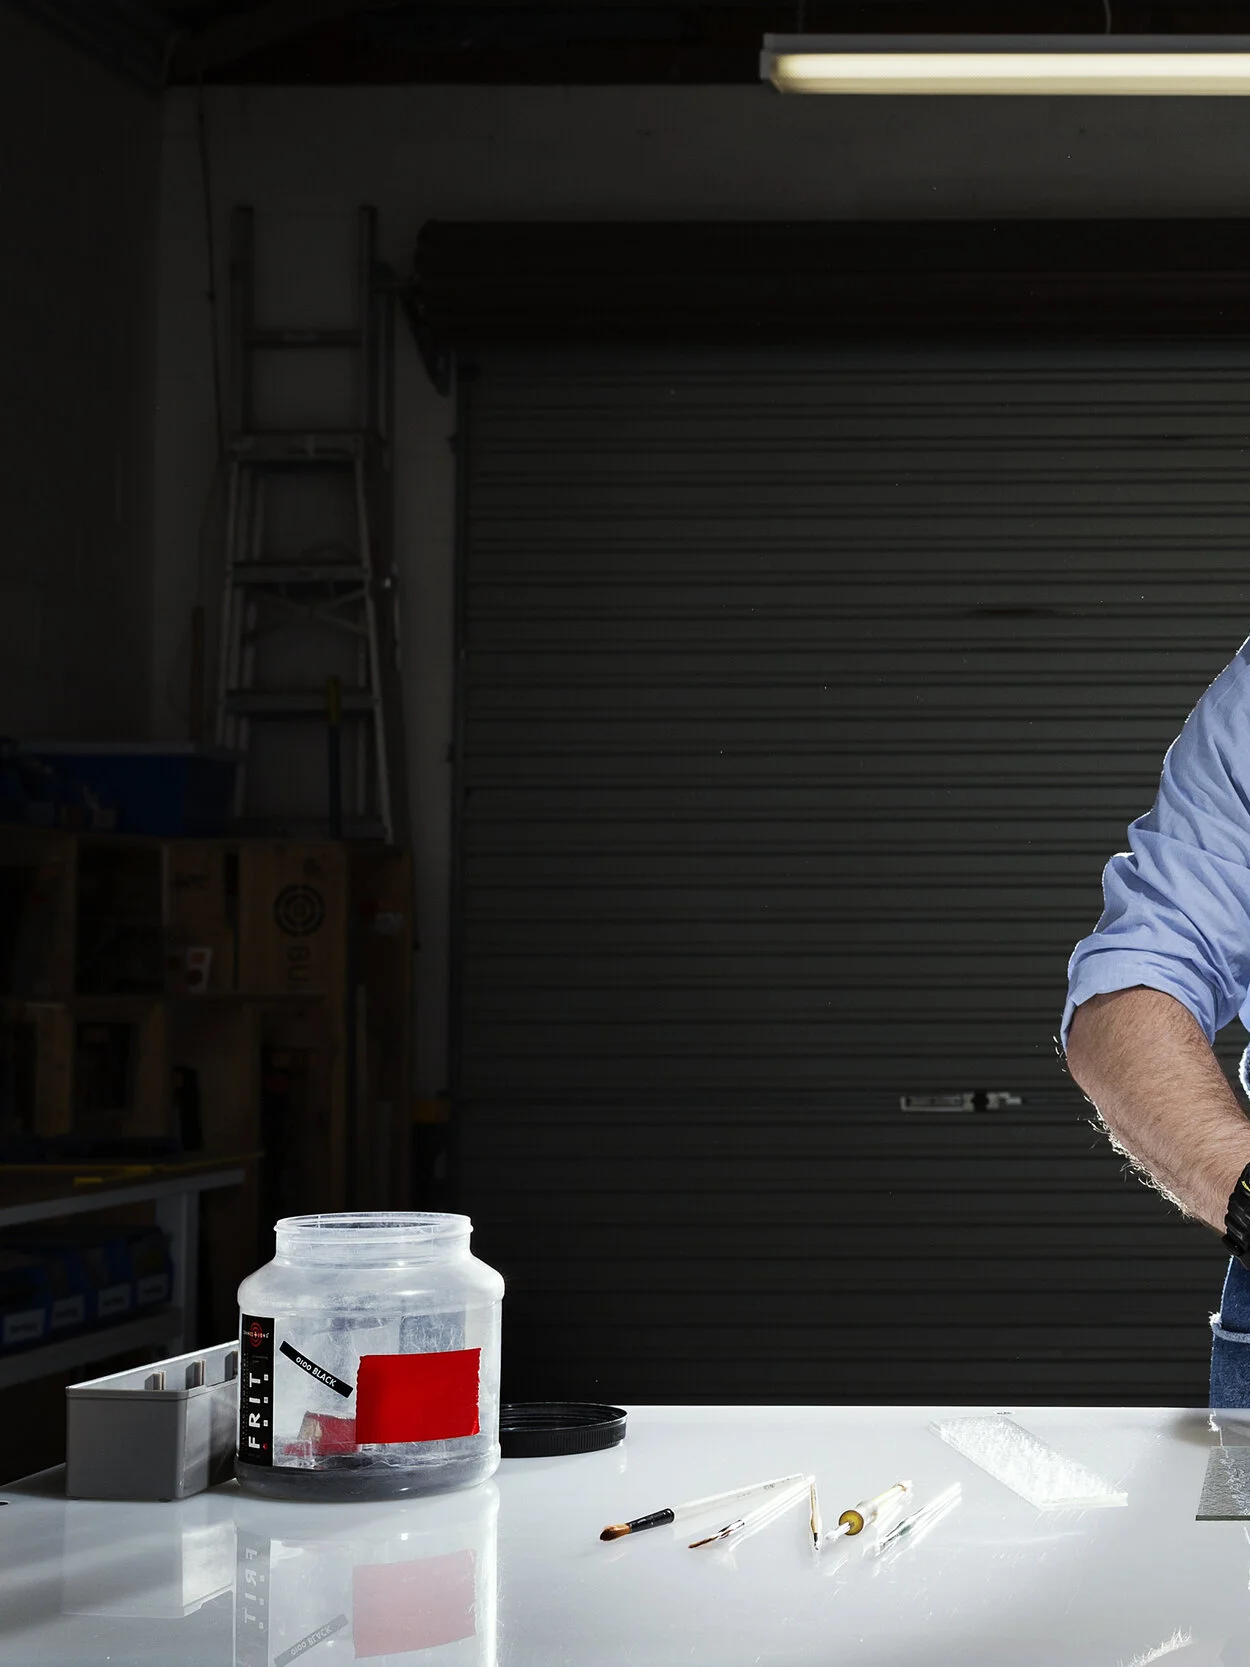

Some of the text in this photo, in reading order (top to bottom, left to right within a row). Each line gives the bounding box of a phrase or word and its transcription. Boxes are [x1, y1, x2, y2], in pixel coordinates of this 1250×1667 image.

[295, 1356, 337, 1387] 0100 BLACK
[248, 1372, 261, 1449] FRIT
